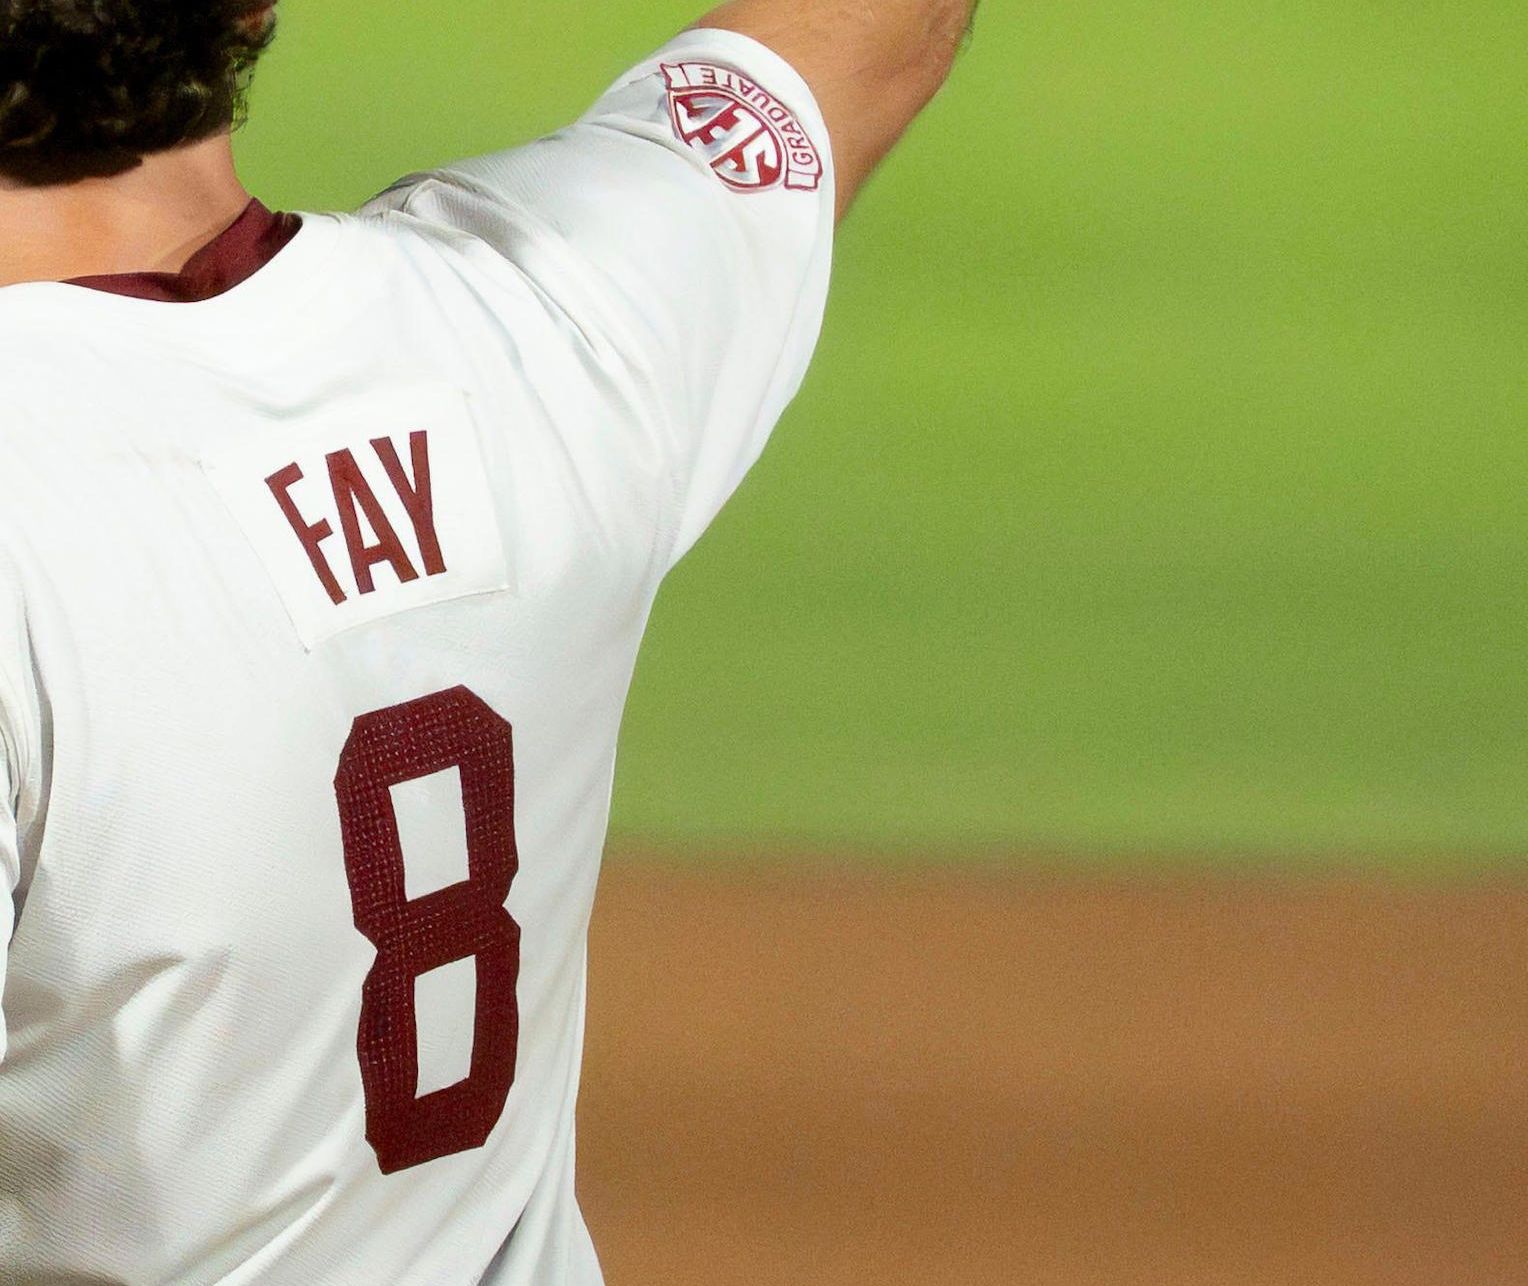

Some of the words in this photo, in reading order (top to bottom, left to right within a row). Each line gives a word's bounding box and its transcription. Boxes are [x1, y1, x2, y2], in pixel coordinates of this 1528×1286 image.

[673, 92, 782, 187] SEC
[700, 66, 815, 166] GRADUATE
[263, 429, 449, 607] FAY
[333, 683, 521, 1176] 8
